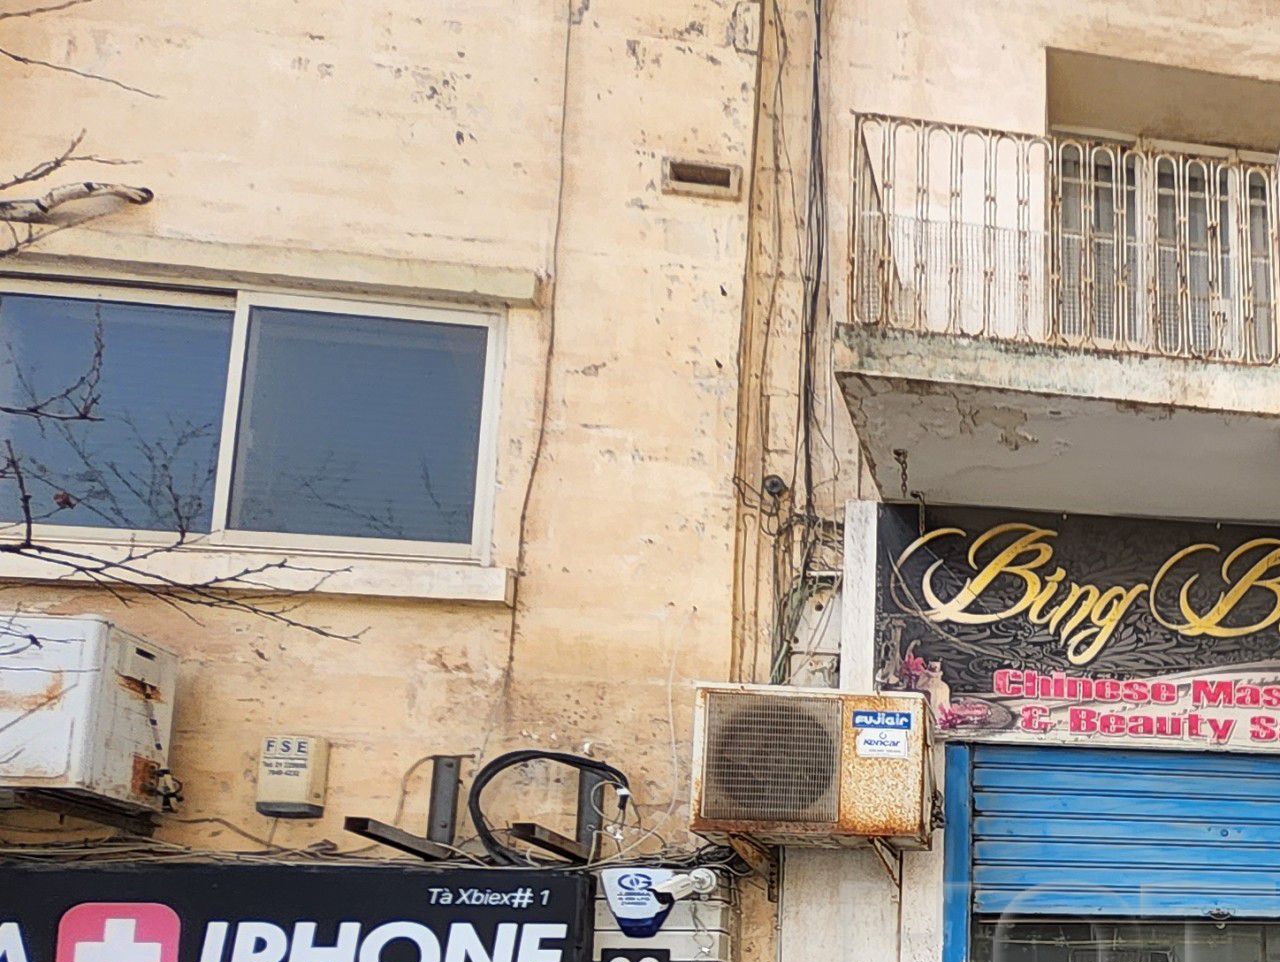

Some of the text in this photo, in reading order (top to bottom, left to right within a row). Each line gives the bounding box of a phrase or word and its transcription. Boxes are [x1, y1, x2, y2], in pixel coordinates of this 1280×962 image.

[890, 522, 1149, 666] Bing
[993, 669, 1179, 702] Chinese
[1020, 708, 1054, 732] &
[1068, 708, 1234, 745] Beauty
[428, 888, 452, 905] Tà
[540, 889, 550, 905] 1
